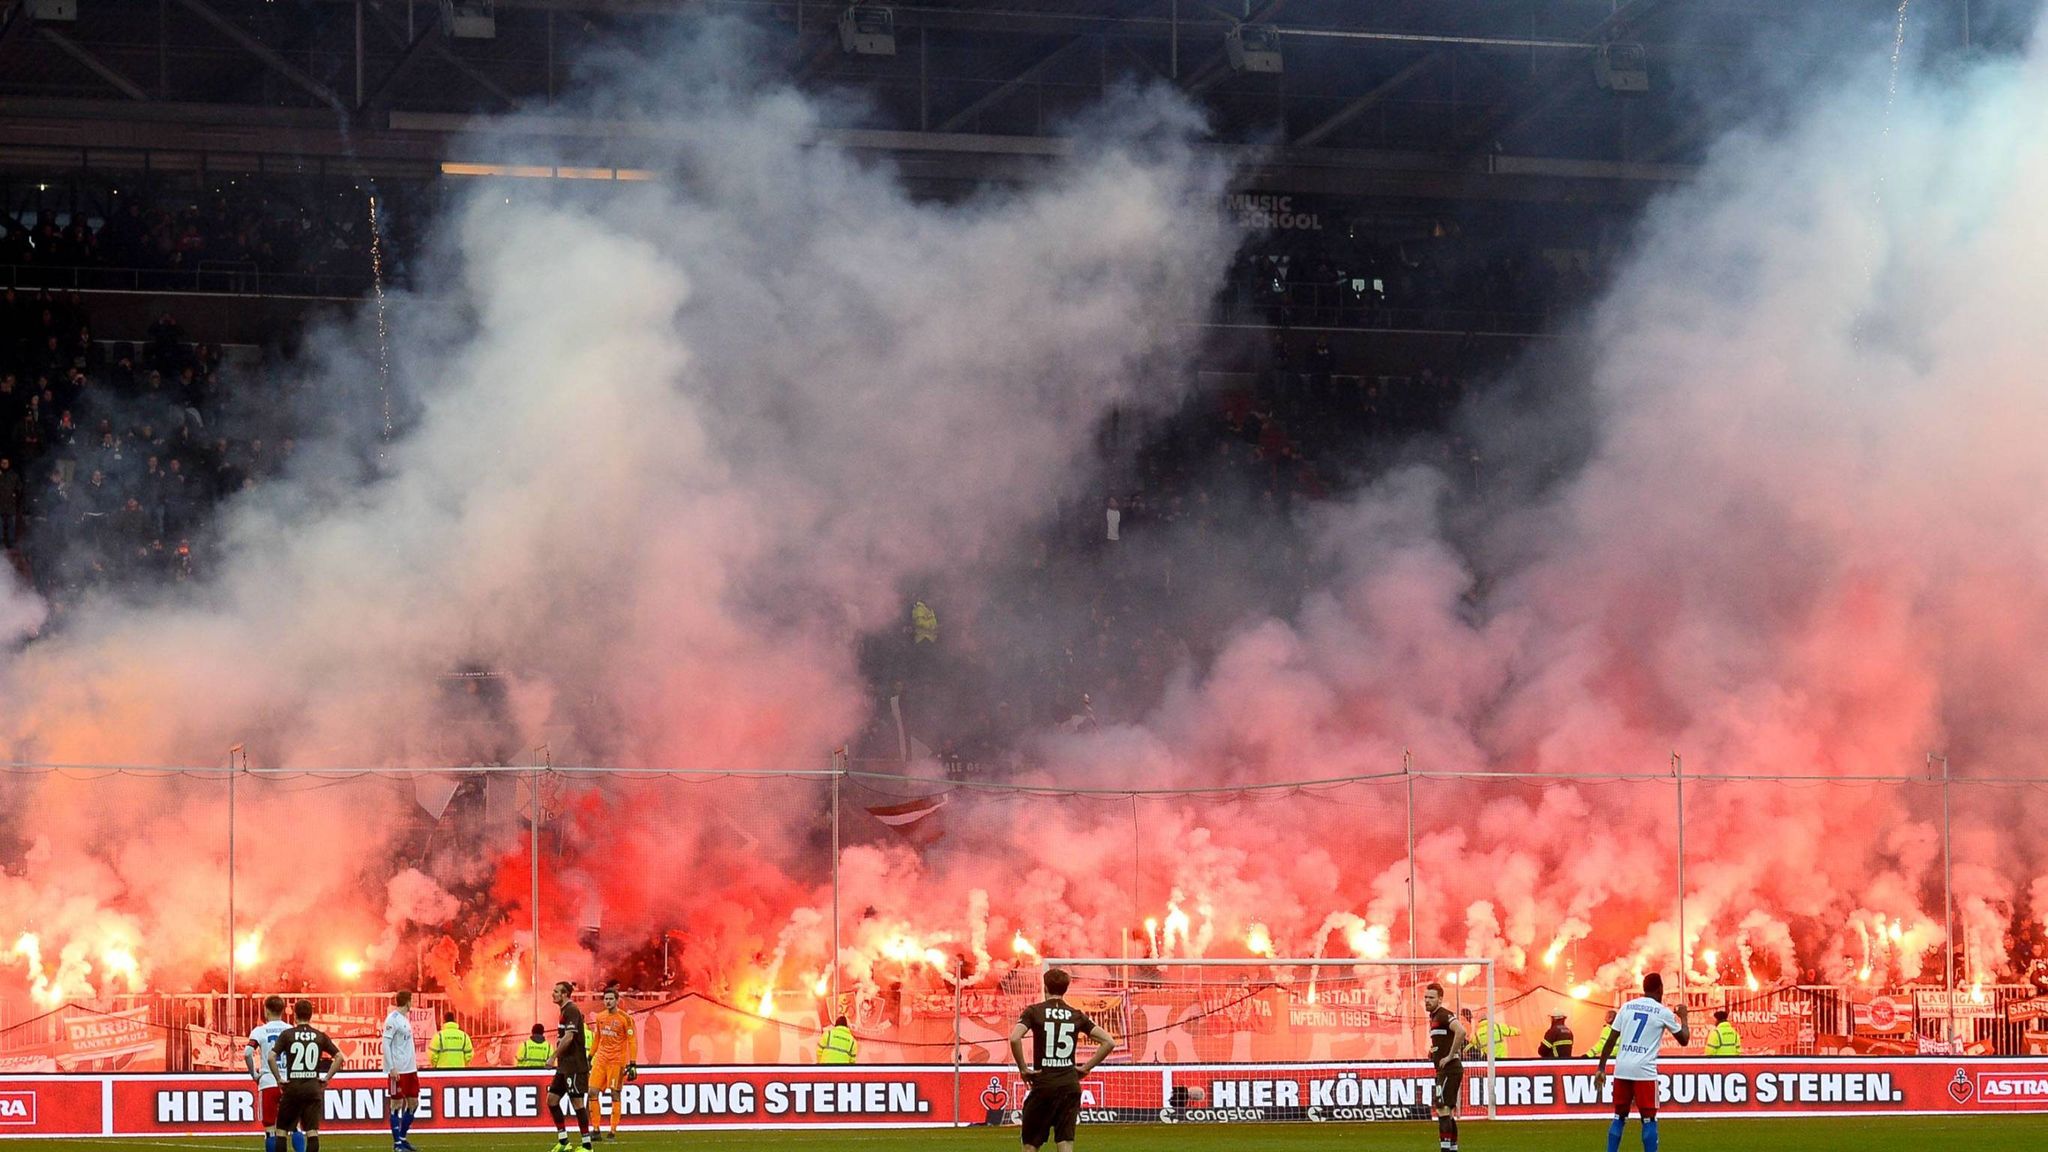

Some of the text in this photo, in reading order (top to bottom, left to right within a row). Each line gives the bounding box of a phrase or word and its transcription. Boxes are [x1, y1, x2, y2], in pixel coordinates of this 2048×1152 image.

[1226, 194, 1292, 212] MUSIC
[1239, 212, 1322, 230] SCHOOL
[1922, 993, 1991, 1004] LA BIGAA
[1045, 1008, 1072, 1020] FCSP
[1779, 1000, 1813, 1016] GNZ
[1290, 1011, 1371, 1027] INFERNO 1999
[1732, 1010, 1778, 1024] MARKUS
[69, 1015, 149, 1040] DARUM
[1633, 1012, 1649, 1043] 7
[294, 1031, 317, 1041] FCSP
[1044, 1021, 1075, 1059] 15
[290, 1041, 319, 1071] 20
[1622, 1044, 1649, 1054] NAREY
[567, 1077, 573, 1087] 9
[1212, 1080, 1299, 1107] HIER
[1310, 1073, 1436, 1106] KÖNNT
[1469, 1075, 1554, 1106] IHRE
[1755, 1072, 1903, 1103] STEHEN.
[1984, 1079, 2048, 1096] ASTRA
[157, 1090, 254, 1122] HIER
[443, 1086, 537, 1118] IHRE
[765, 1081, 929, 1114] STEHEN.
[1185, 1107, 1265, 1123] congstar
[1333, 1105, 1411, 1121] congstar
